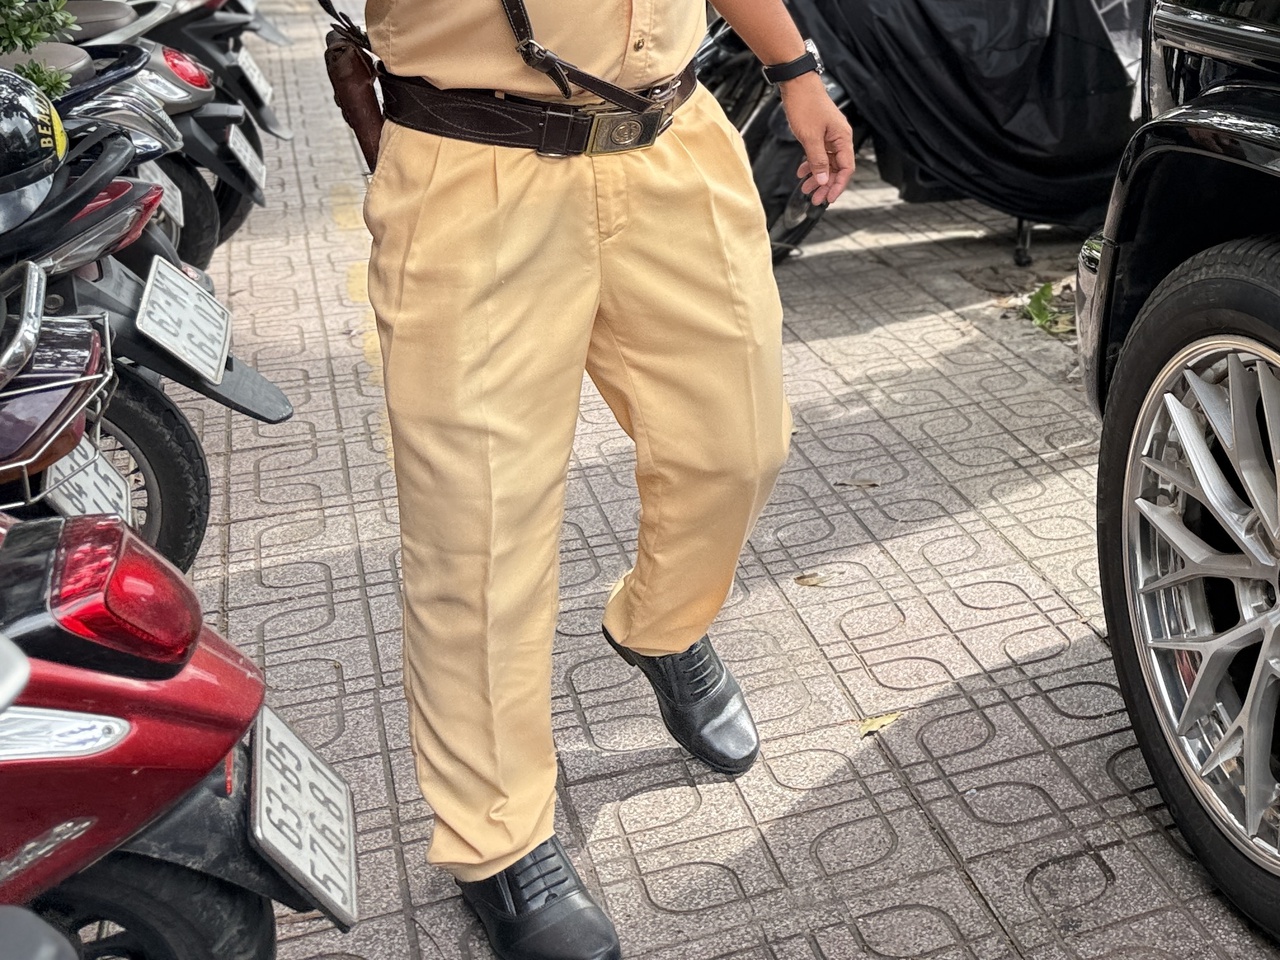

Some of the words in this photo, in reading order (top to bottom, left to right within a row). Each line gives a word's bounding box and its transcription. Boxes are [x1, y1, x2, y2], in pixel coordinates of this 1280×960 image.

[183, 292, 226, 372] 164.02
[265, 726, 303, 851] 63-B5
[307, 756, 348, 906] 576.81
